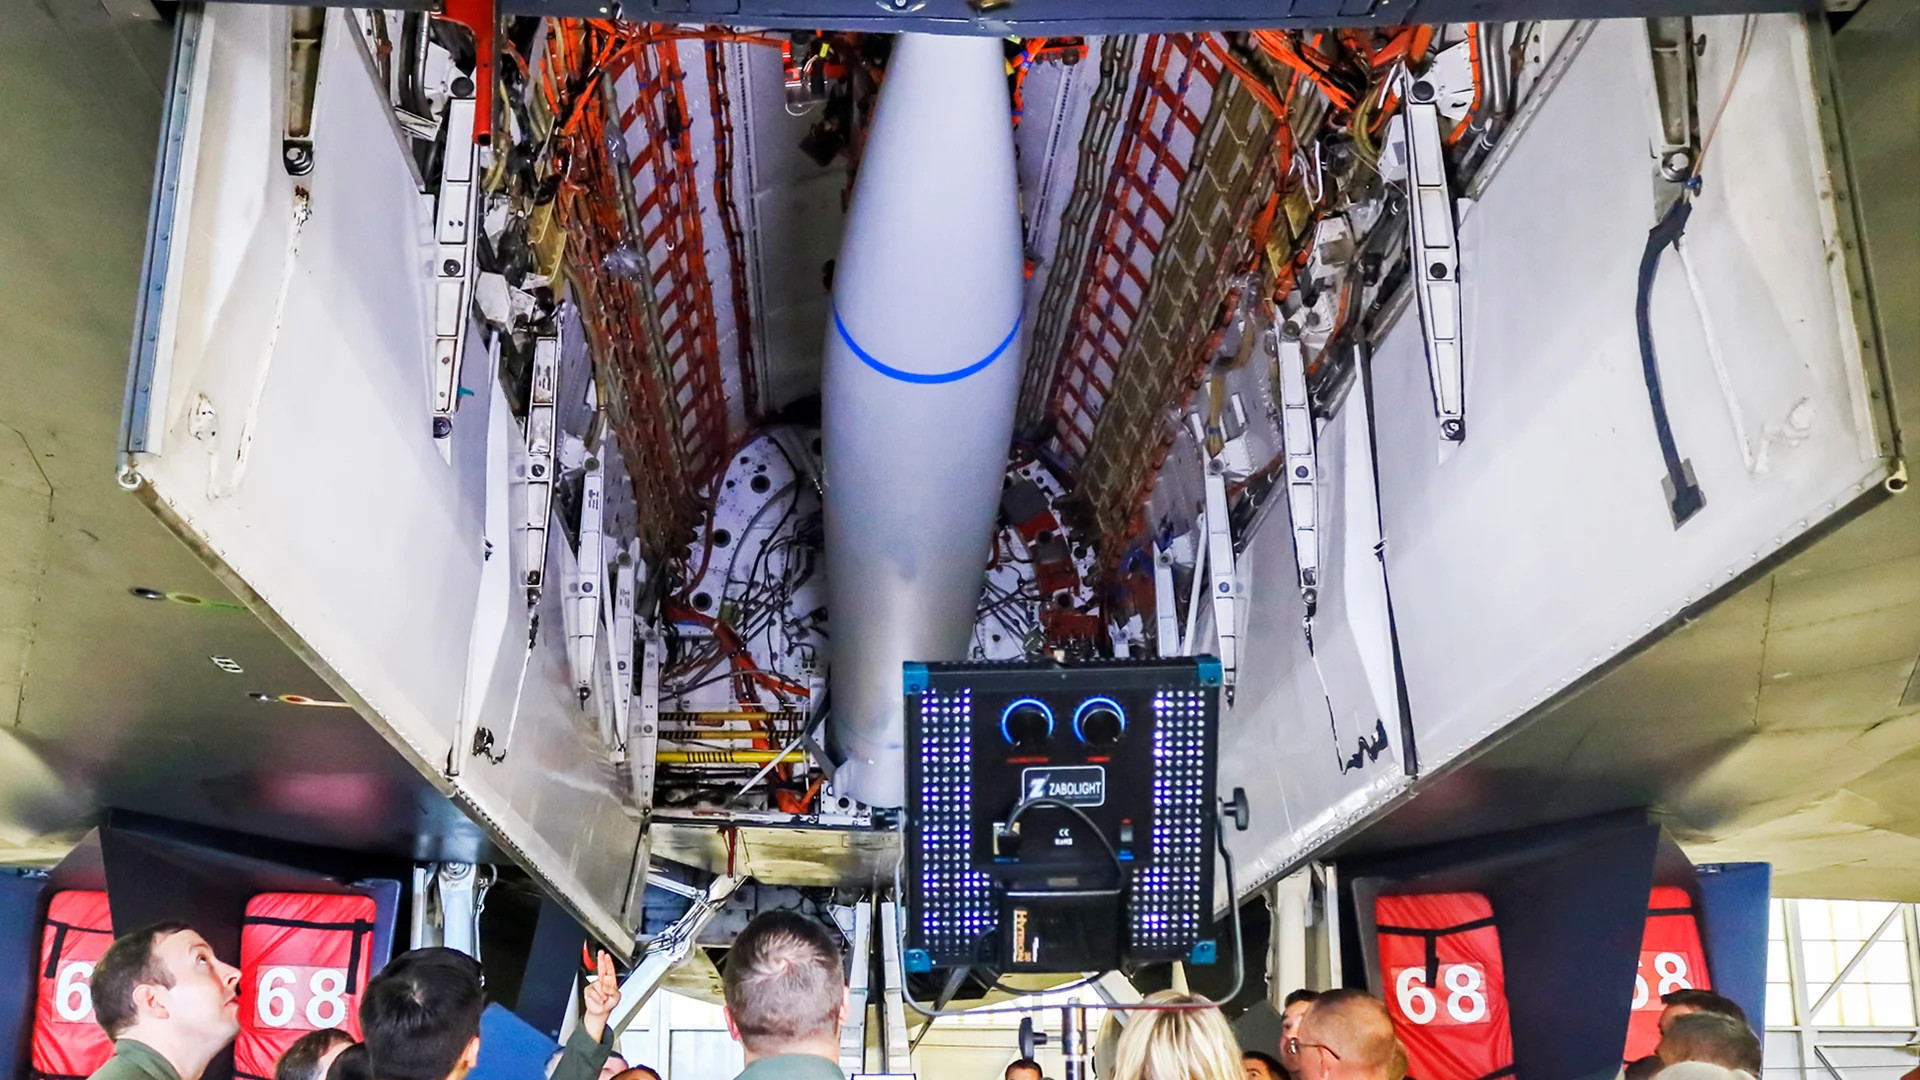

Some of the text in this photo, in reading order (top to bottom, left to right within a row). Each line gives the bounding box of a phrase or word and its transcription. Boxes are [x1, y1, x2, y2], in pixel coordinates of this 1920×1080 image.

[1048, 781, 1102, 796] ZABOLIGHT
[257, 967, 346, 1028] 68
[1395, 963, 1487, 1024] 68
